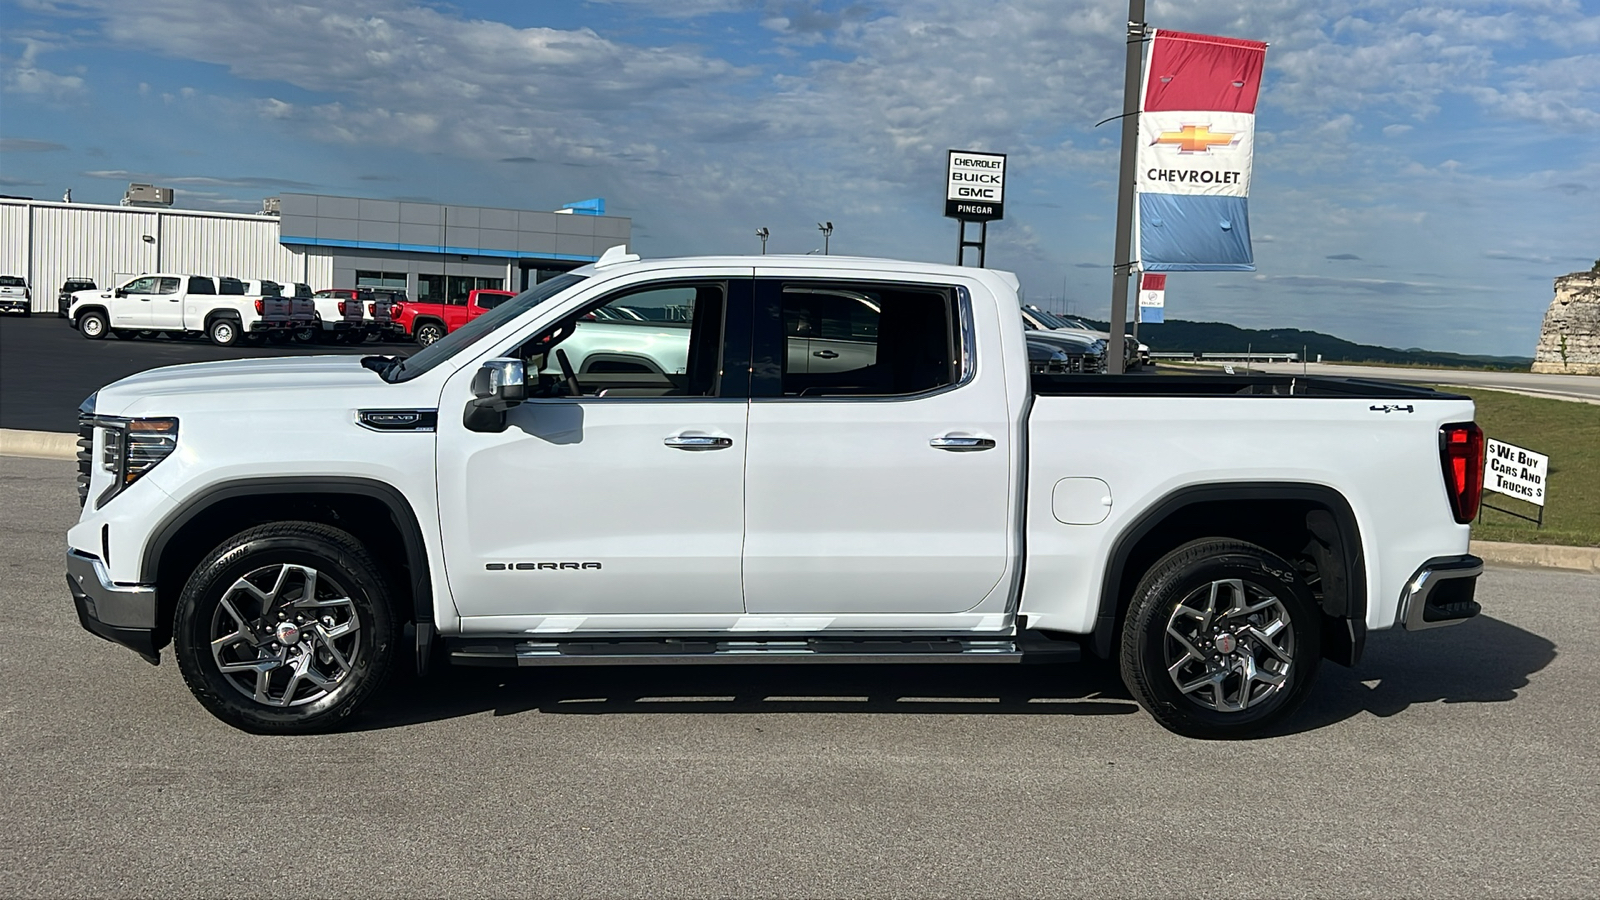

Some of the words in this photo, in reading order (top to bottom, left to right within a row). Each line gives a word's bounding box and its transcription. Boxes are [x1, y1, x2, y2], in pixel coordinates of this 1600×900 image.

[954, 157, 1001, 169] CHEVROLET
[952, 172, 1001, 184] BUICK
[1147, 168, 1240, 184] CHEVROLET
[958, 187, 994, 198] GMC
[957, 204, 993, 214] PINEGAR
[485, 562, 602, 570] SIERRA
